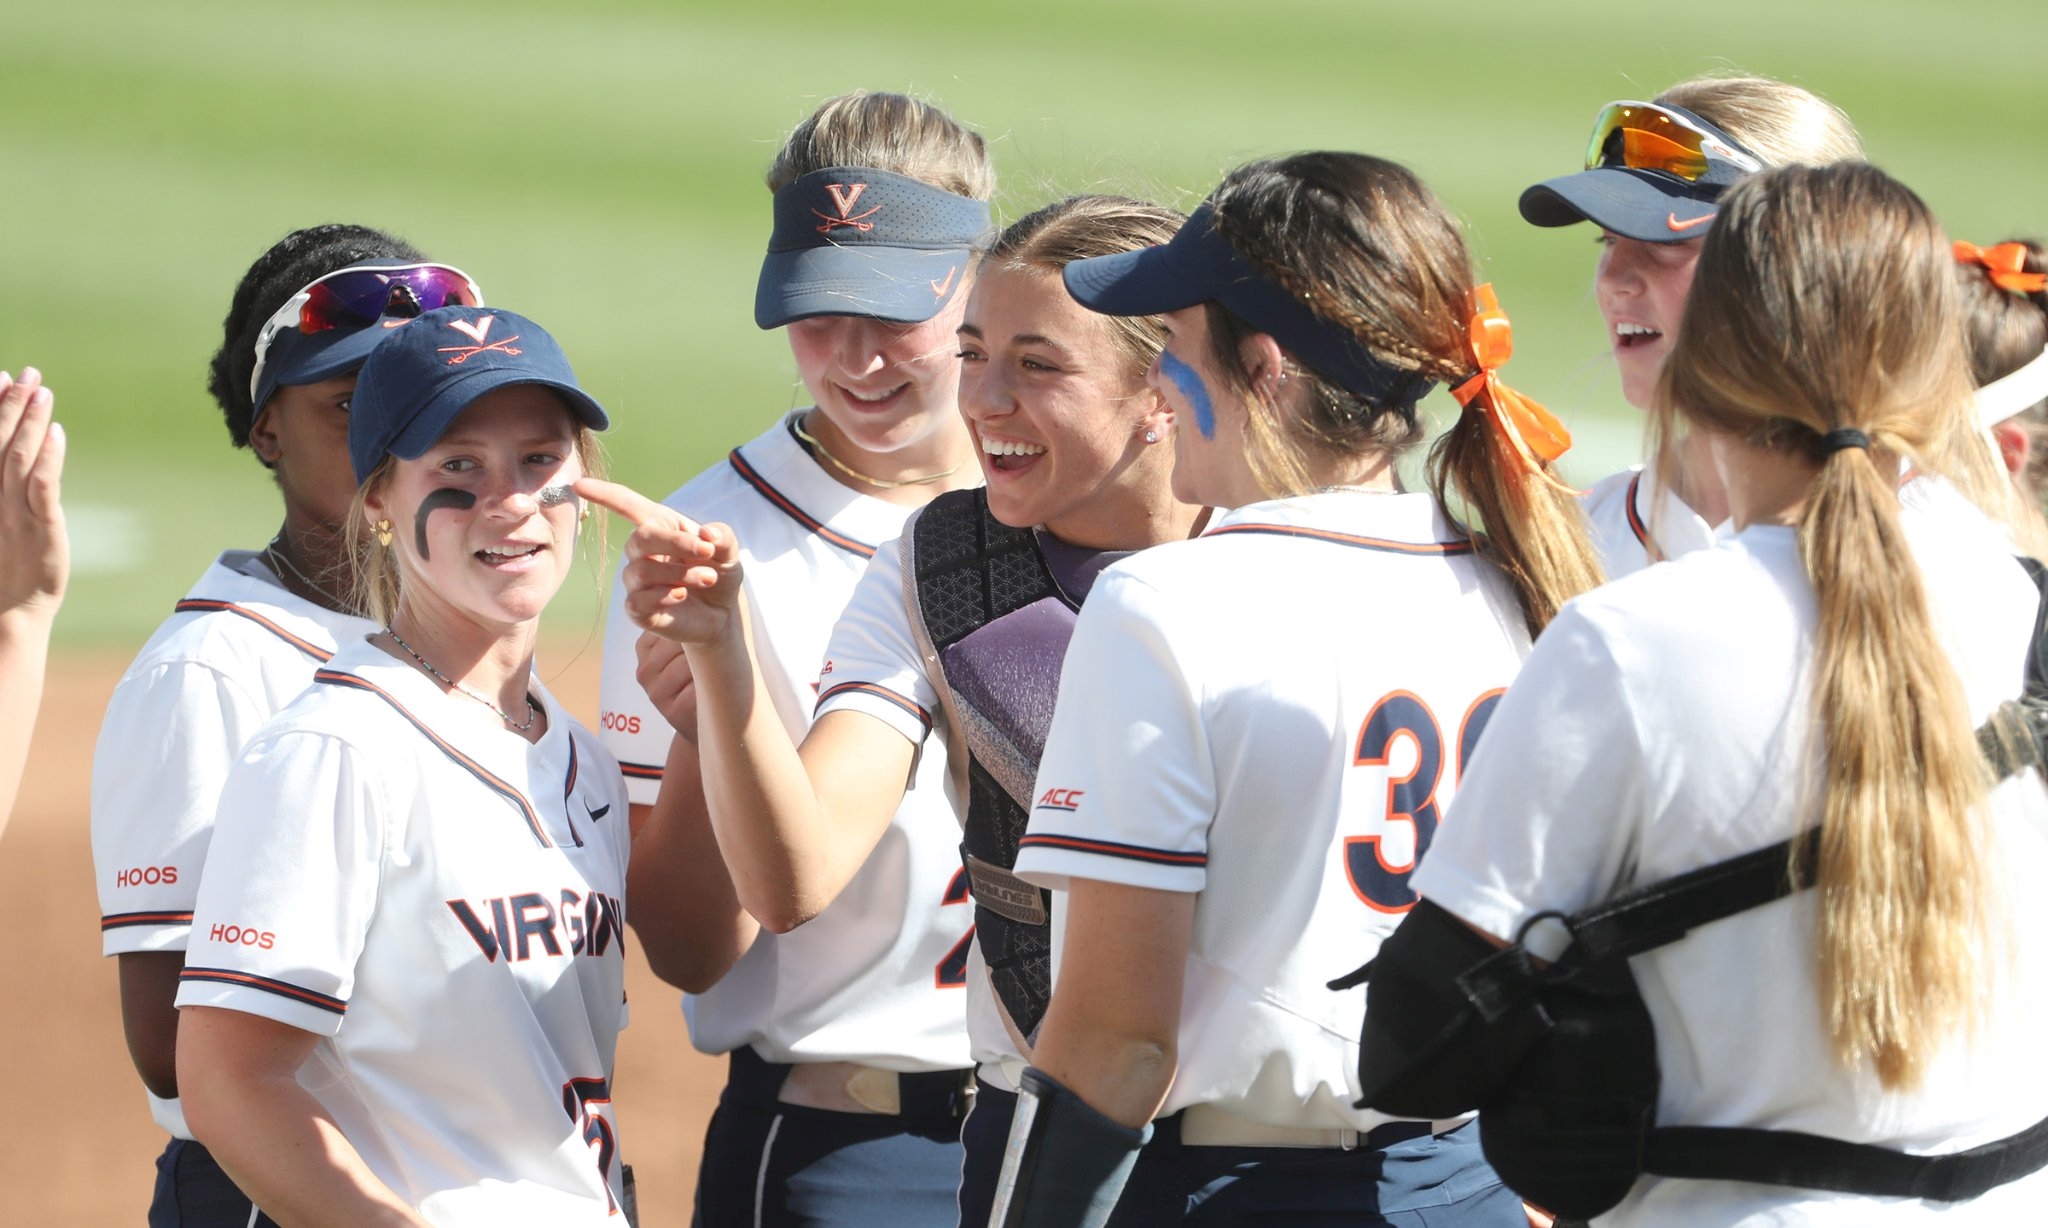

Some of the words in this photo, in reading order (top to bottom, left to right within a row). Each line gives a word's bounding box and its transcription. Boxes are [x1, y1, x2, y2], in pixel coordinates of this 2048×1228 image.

[447, 314, 494, 345] V
[601, 710, 641, 734] HOOS
[1038, 788, 1085, 807] ACC
[1343, 687, 1510, 914] 3
[117, 866, 178, 888] HOOS
[210, 923, 276, 950] HOOS
